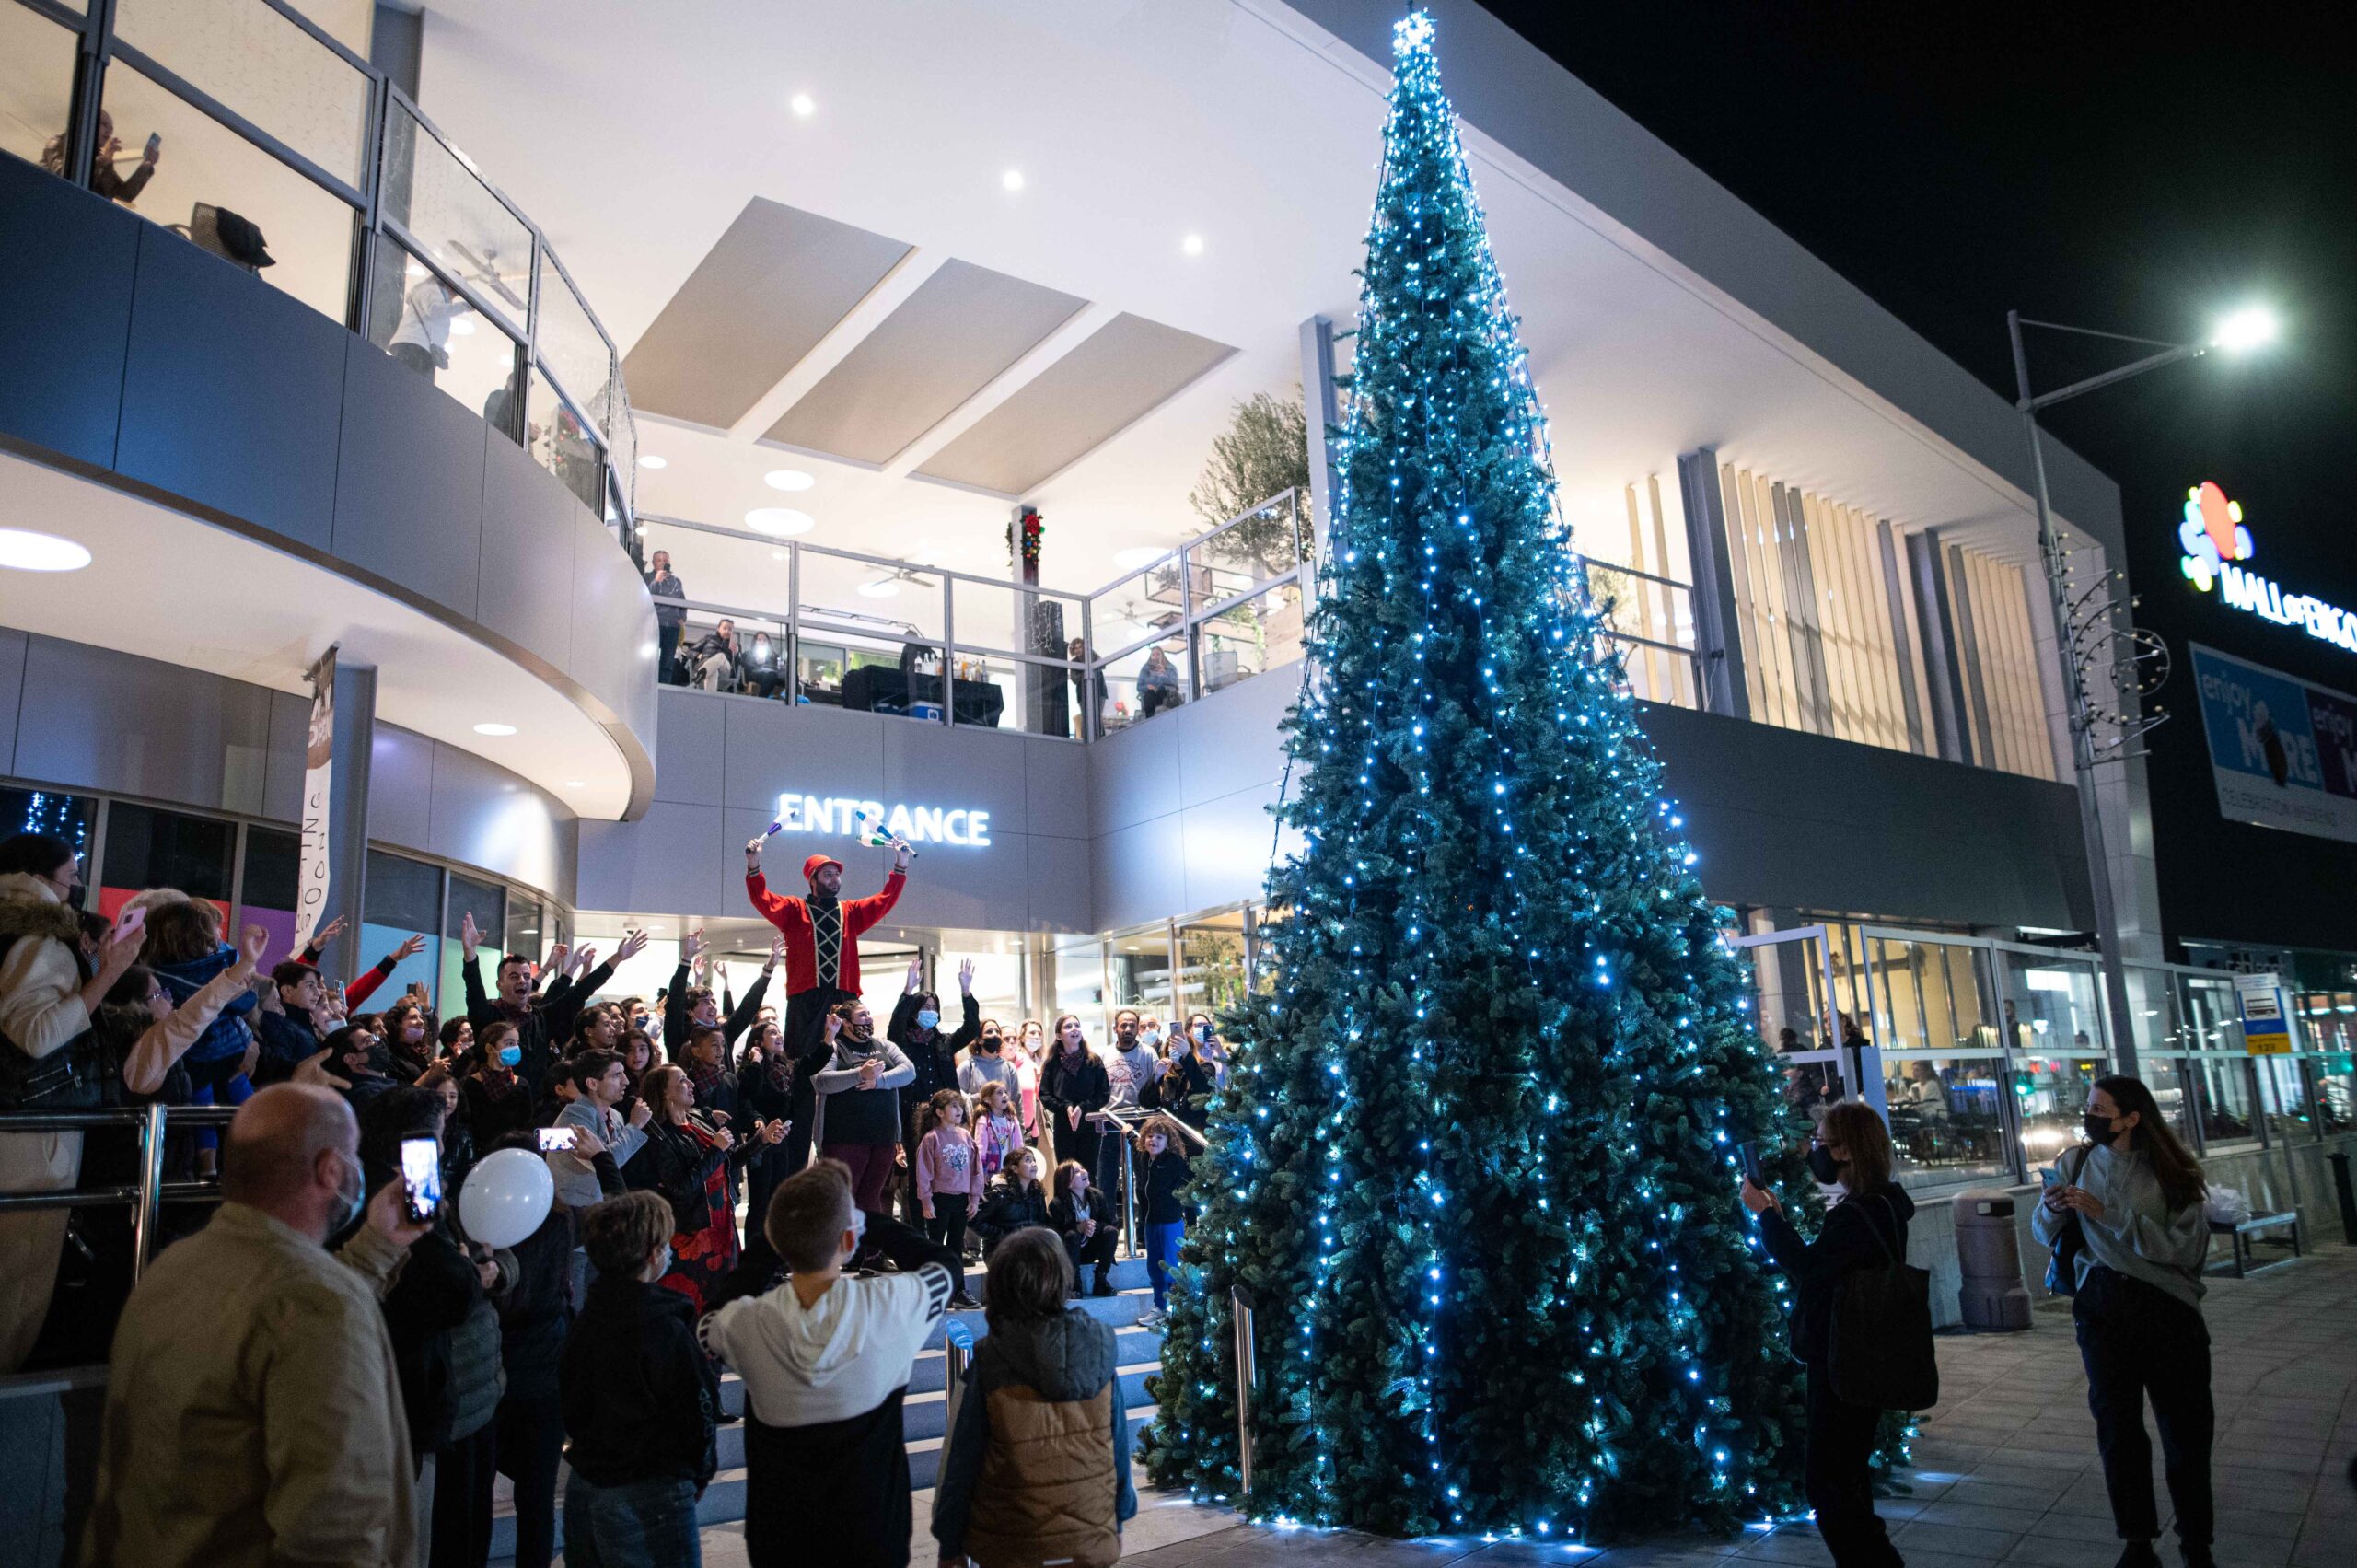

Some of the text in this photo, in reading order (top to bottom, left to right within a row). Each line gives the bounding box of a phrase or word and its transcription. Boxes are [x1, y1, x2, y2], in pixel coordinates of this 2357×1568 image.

[2201, 670, 2253, 720] enjoy
[2237, 716, 2318, 784] MRE
[778, 793, 992, 847] ENTRANCE
